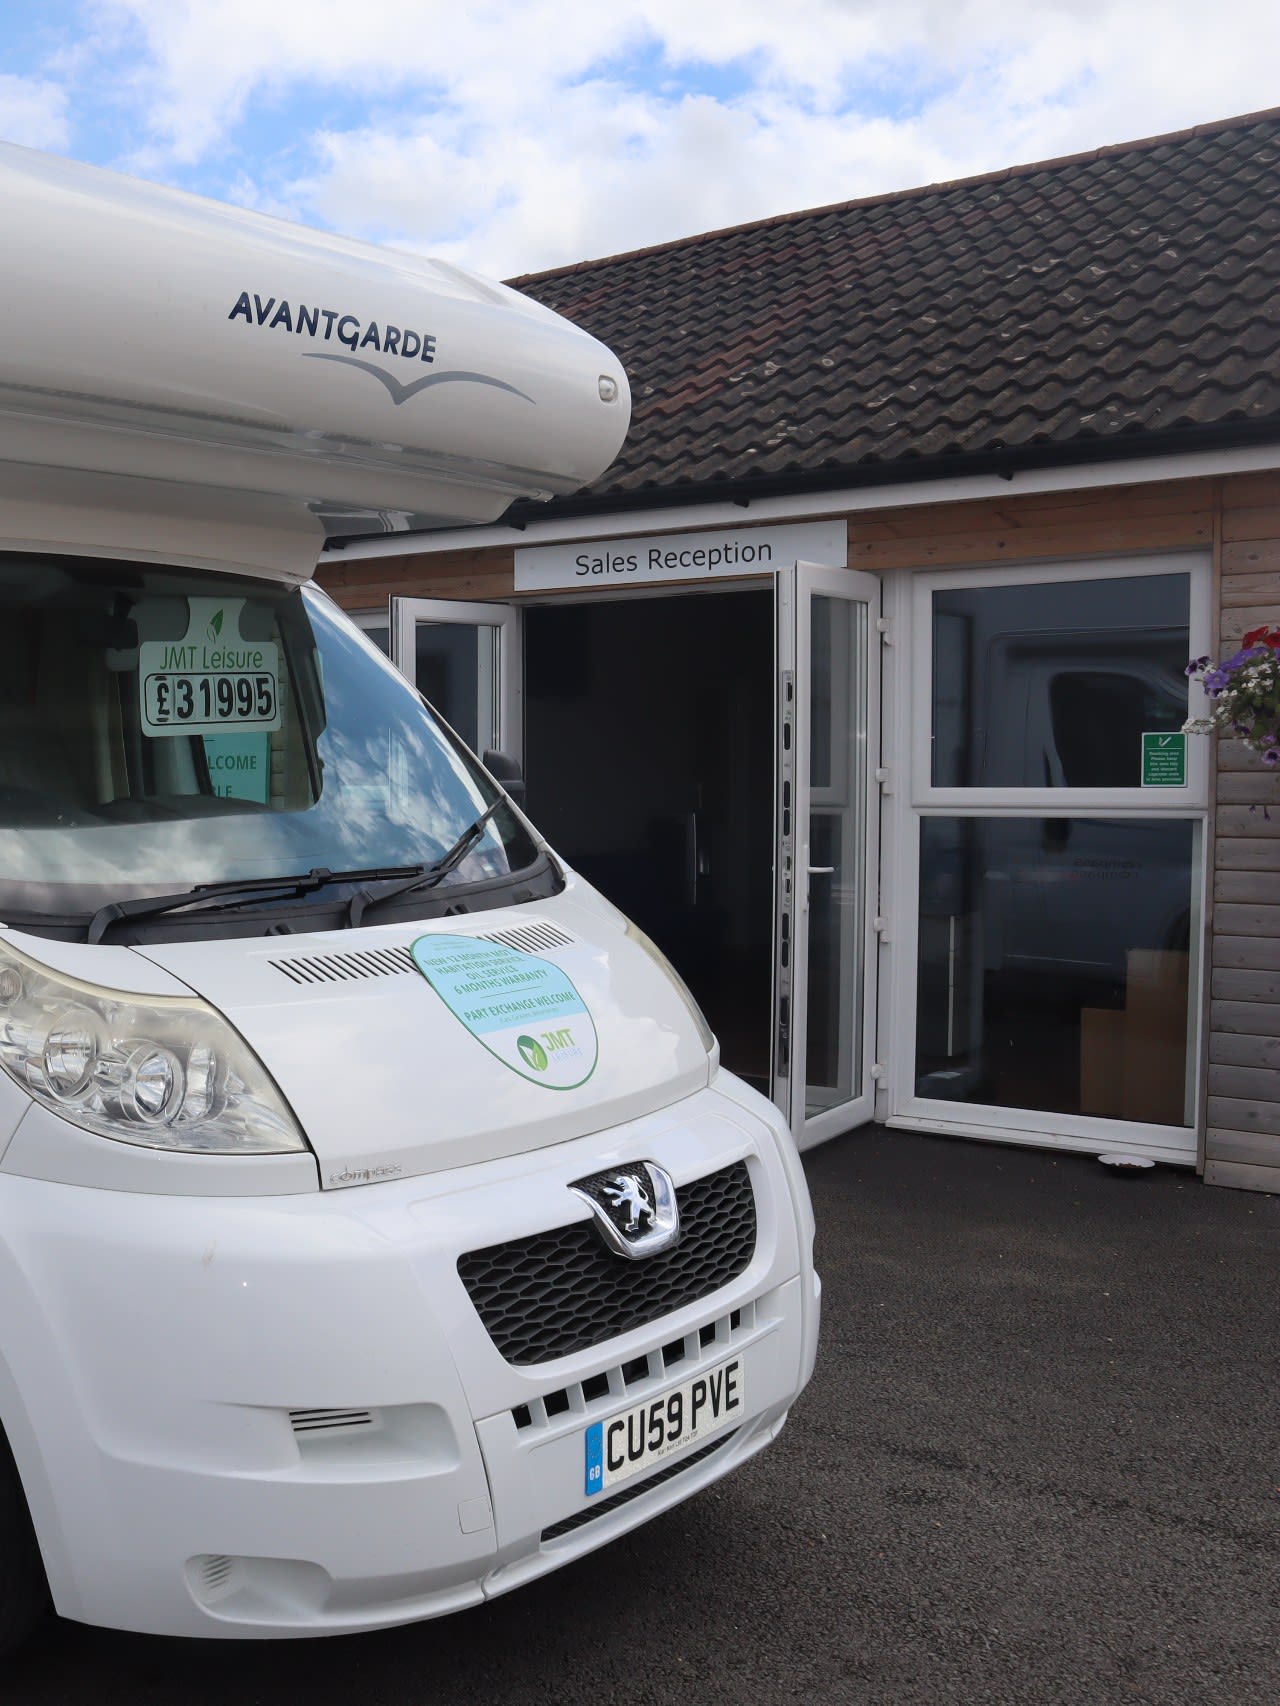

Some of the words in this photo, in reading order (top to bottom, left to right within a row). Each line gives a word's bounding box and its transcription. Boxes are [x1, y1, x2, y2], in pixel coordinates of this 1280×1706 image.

[228, 291, 436, 363] AVANTGARDE
[575, 553, 638, 576] Sales
[648, 541, 773, 570] Reception
[160, 646, 197, 670] JMT
[203, 646, 263, 669] Leisure
[207, 755, 257, 770] LCOME
[454, 985, 463, 995] 6
[461, 977, 503, 993] MONTHS
[501, 968, 549, 986] WARRANTY
[466, 970, 483, 980] OIL
[482, 964, 519, 977] SERVICE
[464, 1007, 491, 1022] PART
[489, 998, 535, 1017] EXCHANGE
[534, 991, 577, 1008] WELCOME
[540, 1028, 577, 1052] JMT
[607, 1391, 683, 1472] CU59
[691, 1360, 740, 1430] PVE
[589, 1464, 601, 1481] GB
